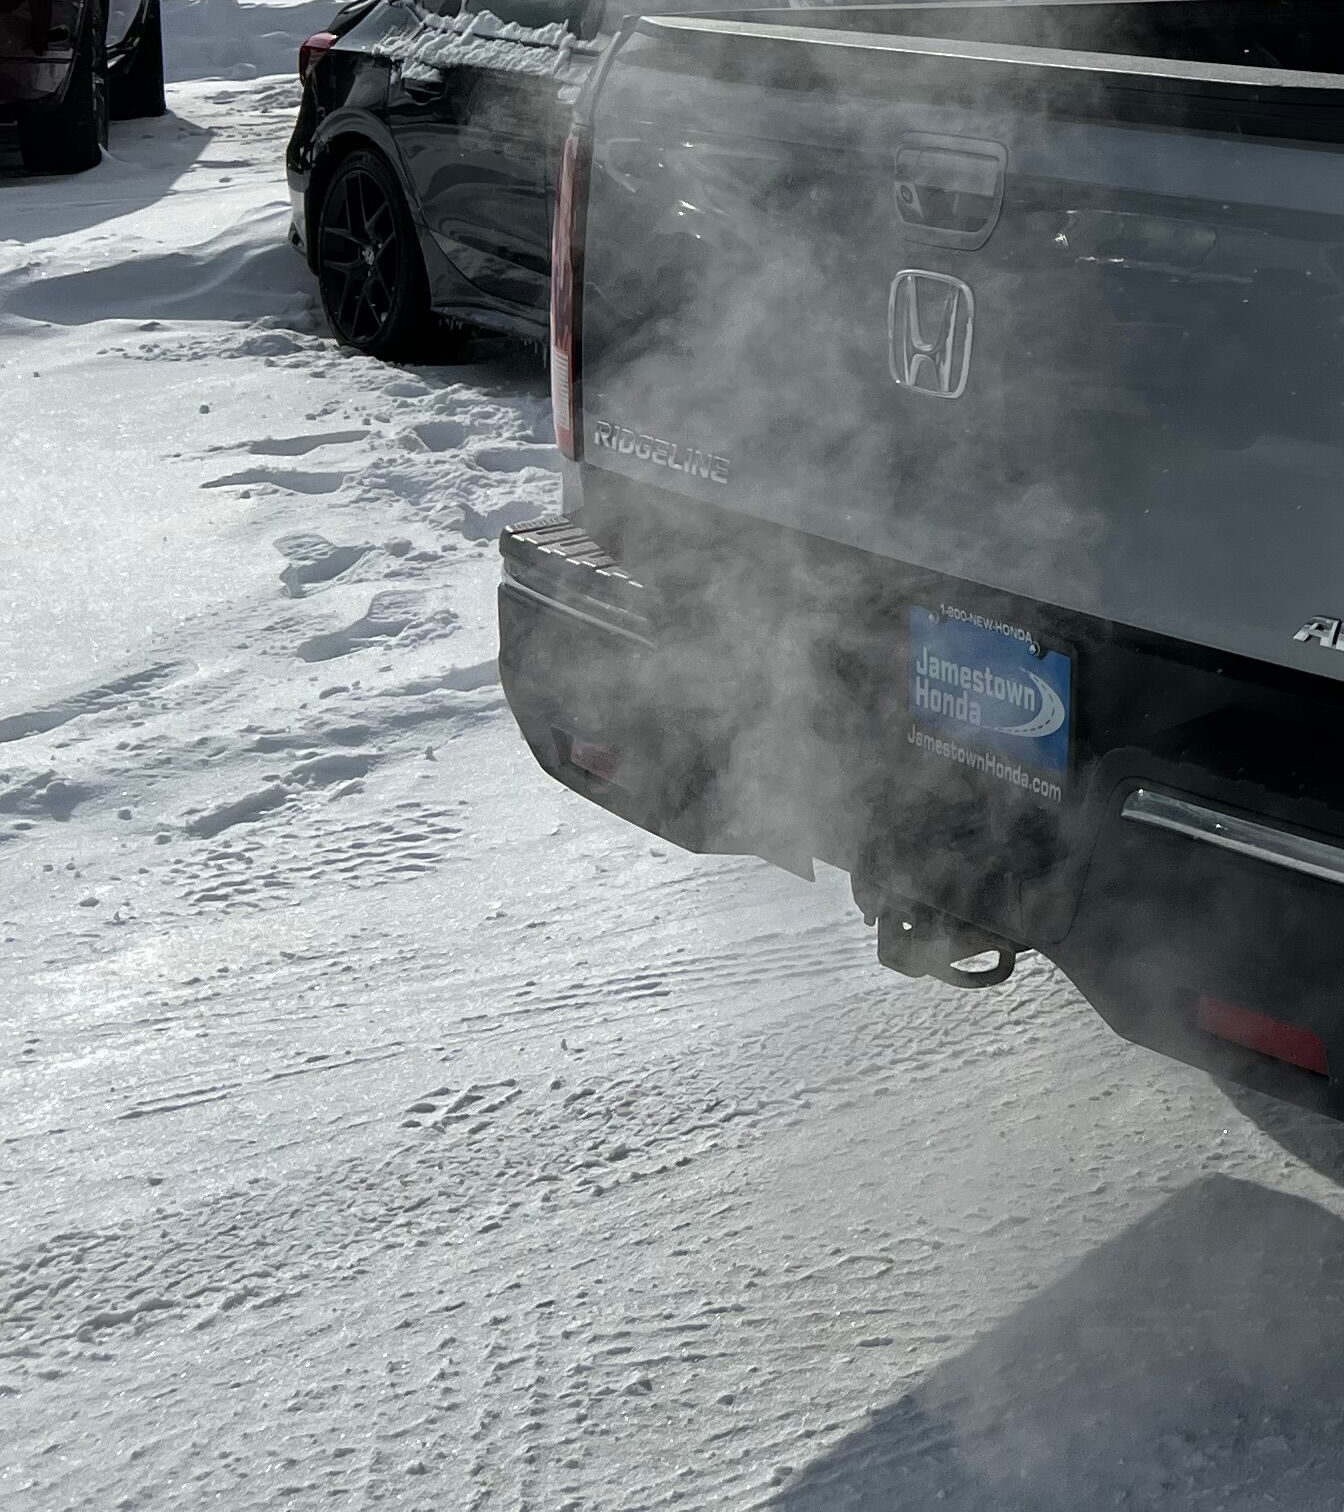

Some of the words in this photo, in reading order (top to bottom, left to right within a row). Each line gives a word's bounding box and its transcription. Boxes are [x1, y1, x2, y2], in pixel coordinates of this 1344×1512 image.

[593, 419, 731, 485] RIDGELINE
[940, 604, 1033, 644] 1-800-NEW-HONDA
[915, 645, 1036, 712] Jamestown
[915, 676, 981, 727] Honda
[907, 723, 1063, 803] JamestownHonda.com
